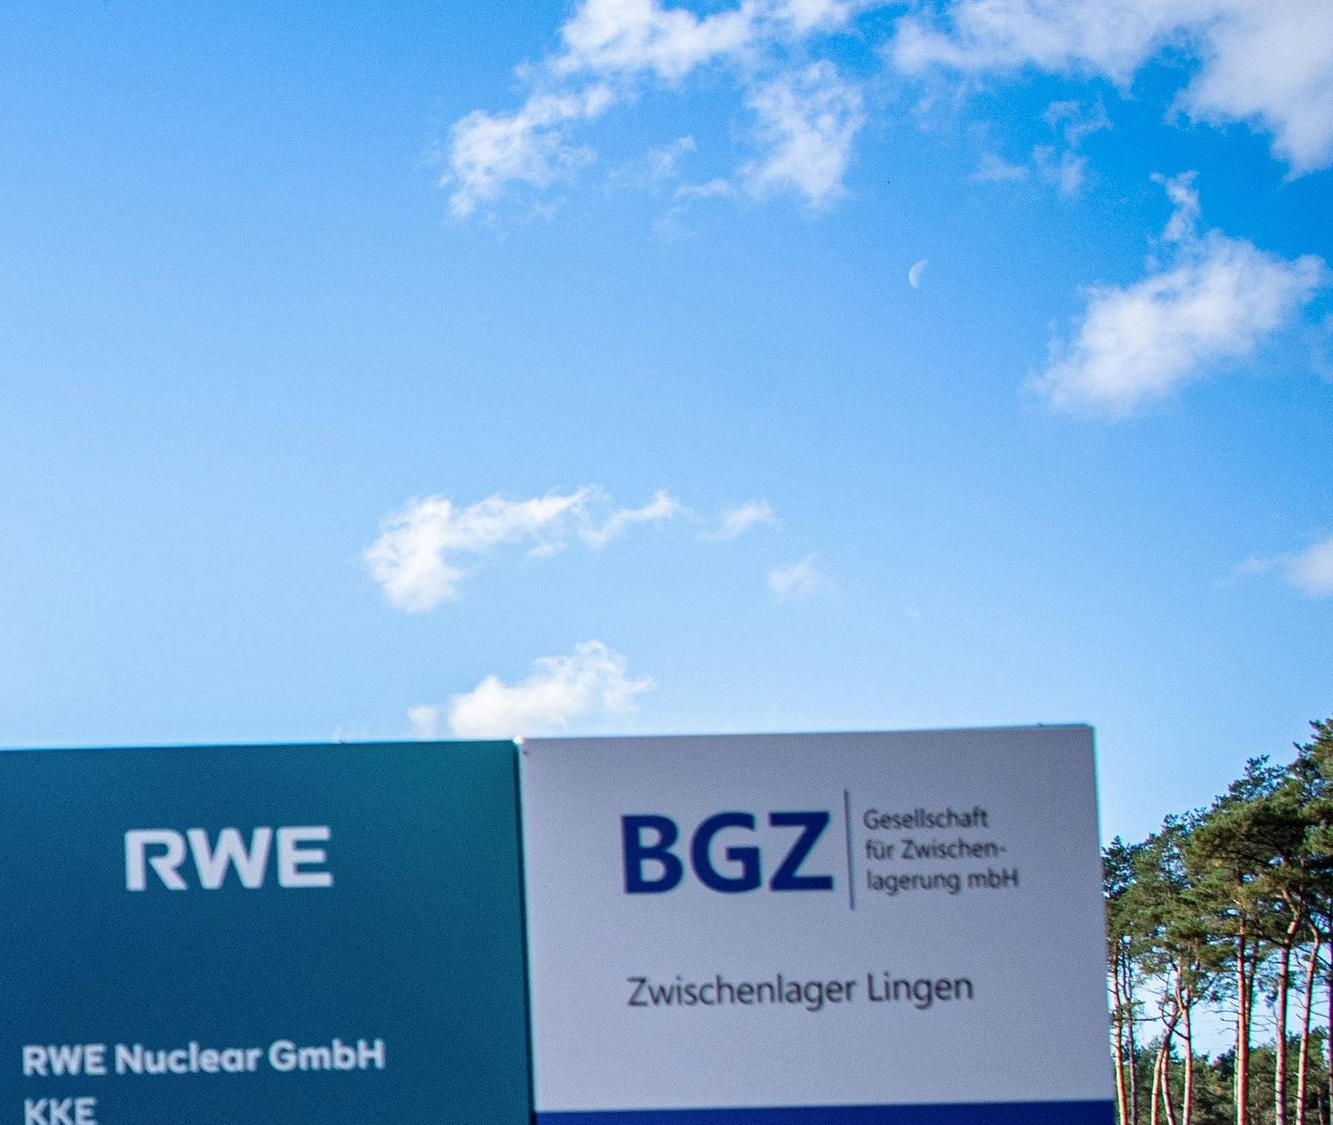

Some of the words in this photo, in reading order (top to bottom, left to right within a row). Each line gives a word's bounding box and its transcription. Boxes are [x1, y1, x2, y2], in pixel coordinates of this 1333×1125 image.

[863, 806, 989, 831] Gesellschaft
[124, 826, 333, 891] RWE
[620, 811, 833, 894] BGZ
[865, 838, 895, 861] für
[900, 838, 1007, 861] Zwischen-
[866, 868, 961, 896] lagerung
[967, 867, 1020, 890] mbH
[626, 974, 856, 1013] Zwischenlager
[867, 972, 974, 1011] Lingen
[22, 1043, 107, 1077] RWE
[115, 1041, 261, 1074] Nuclear
[268, 1038, 386, 1071] GmbH
